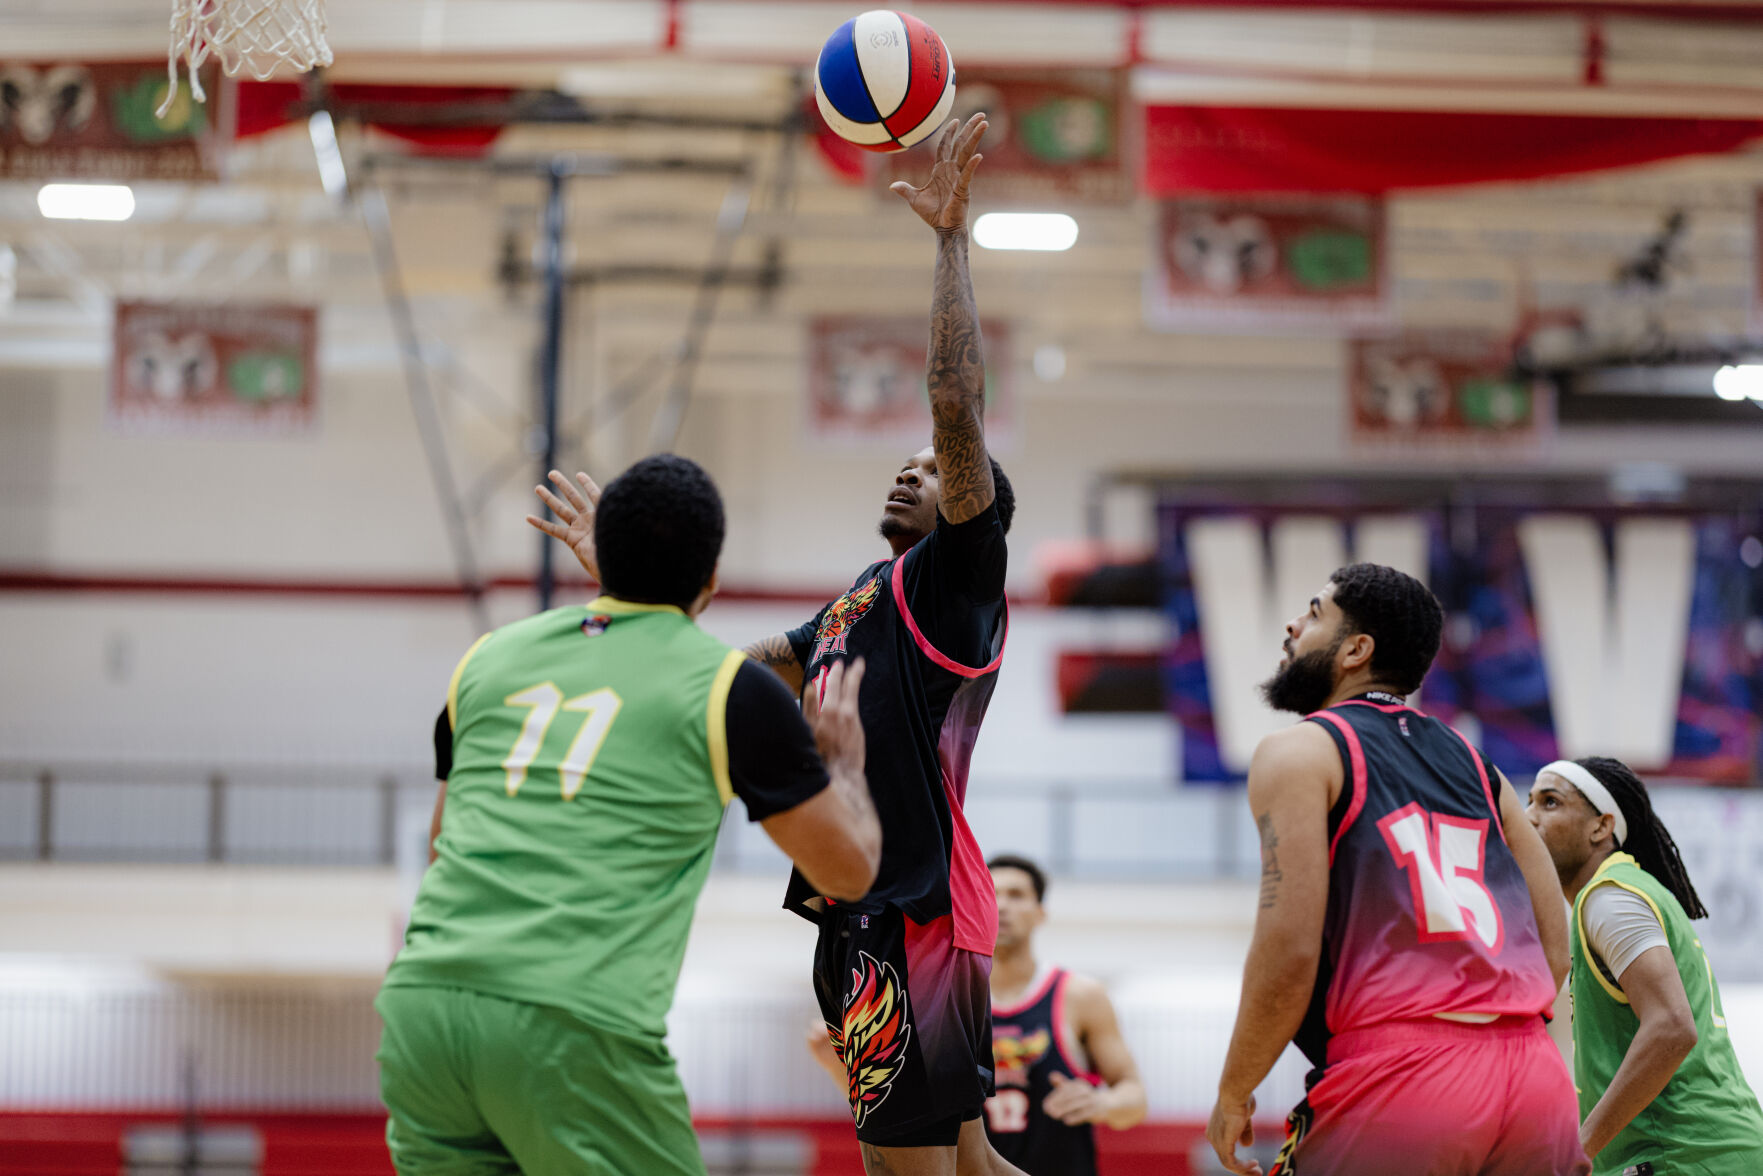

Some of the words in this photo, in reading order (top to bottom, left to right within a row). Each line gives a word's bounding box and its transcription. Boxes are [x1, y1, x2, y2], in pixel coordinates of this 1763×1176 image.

[811, 633, 848, 666] HEAT
[1367, 691, 1392, 702] NIKE
[502, 681, 623, 802] 11
[1376, 801, 1504, 957] 15
